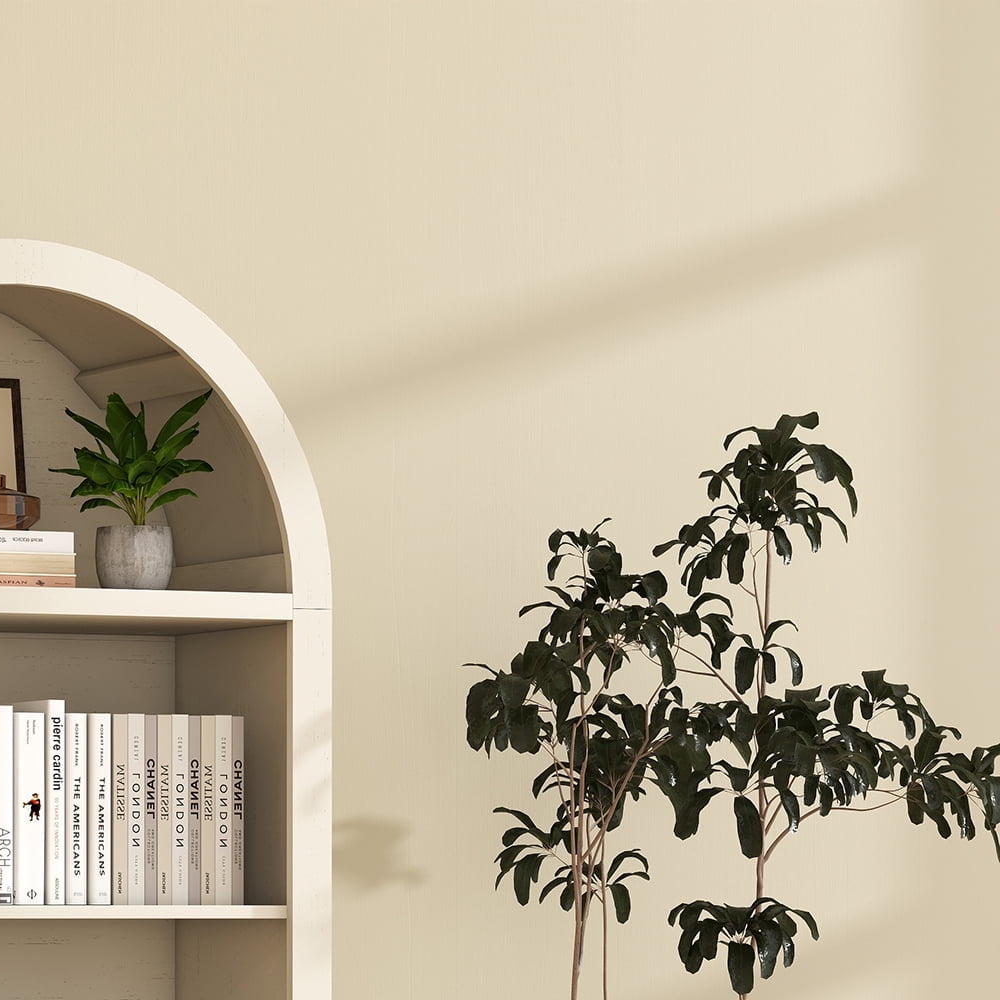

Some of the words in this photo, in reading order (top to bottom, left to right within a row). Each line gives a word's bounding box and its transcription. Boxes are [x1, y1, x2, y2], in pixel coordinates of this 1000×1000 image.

[51, 717, 63, 751] pierre
[53, 754, 63, 791] cardin
[73, 777, 81, 800] THE
[98, 777, 106, 800] THE
[73, 804, 81, 877] AMERICANS
[98, 804, 106, 877] AMERICANS
